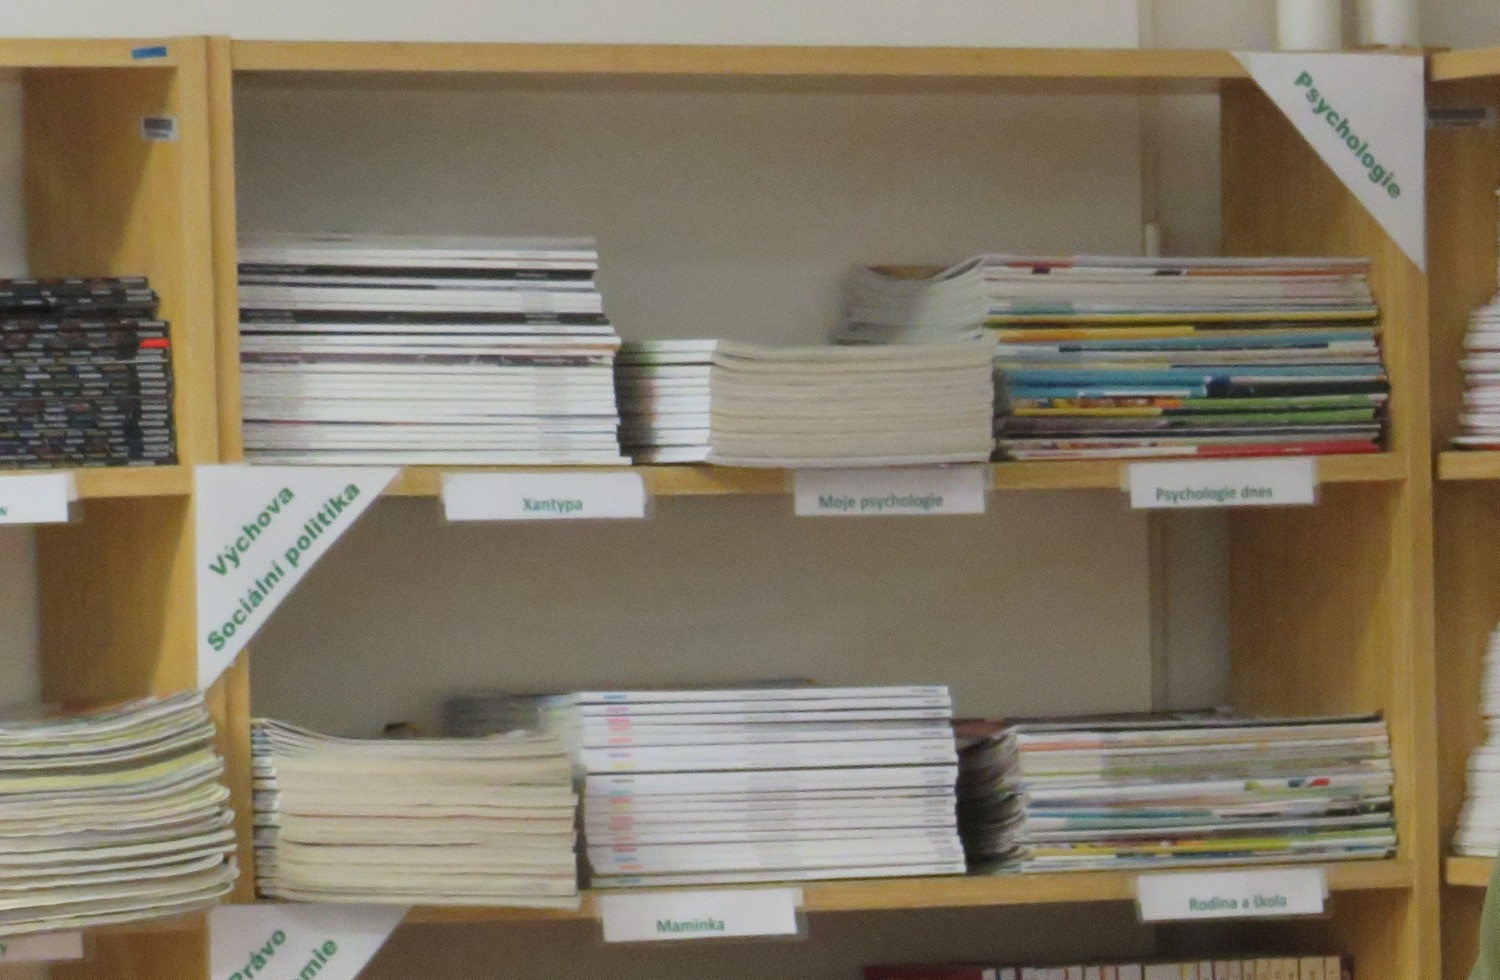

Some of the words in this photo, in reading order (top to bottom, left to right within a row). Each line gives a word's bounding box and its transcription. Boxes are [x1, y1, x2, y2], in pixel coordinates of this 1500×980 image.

[1294, 70, 1401, 199] Psychologie
[818, 495, 856, 511] Moje
[861, 493, 943, 511] psychologie
[1156, 486, 1236, 503] Psychologie
[1241, 486, 1273, 499] dnes
[523, 498, 583, 513] Xantypa
[208, 487, 294, 576] Výchova
[207, 560, 286, 651] Sociální
[284, 483, 361, 568] politika
[1189, 897, 1238, 911] Rodina
[1241, 899, 1250, 909] a
[1254, 894, 1288, 908] škola
[656, 918, 725, 932] Maminka
